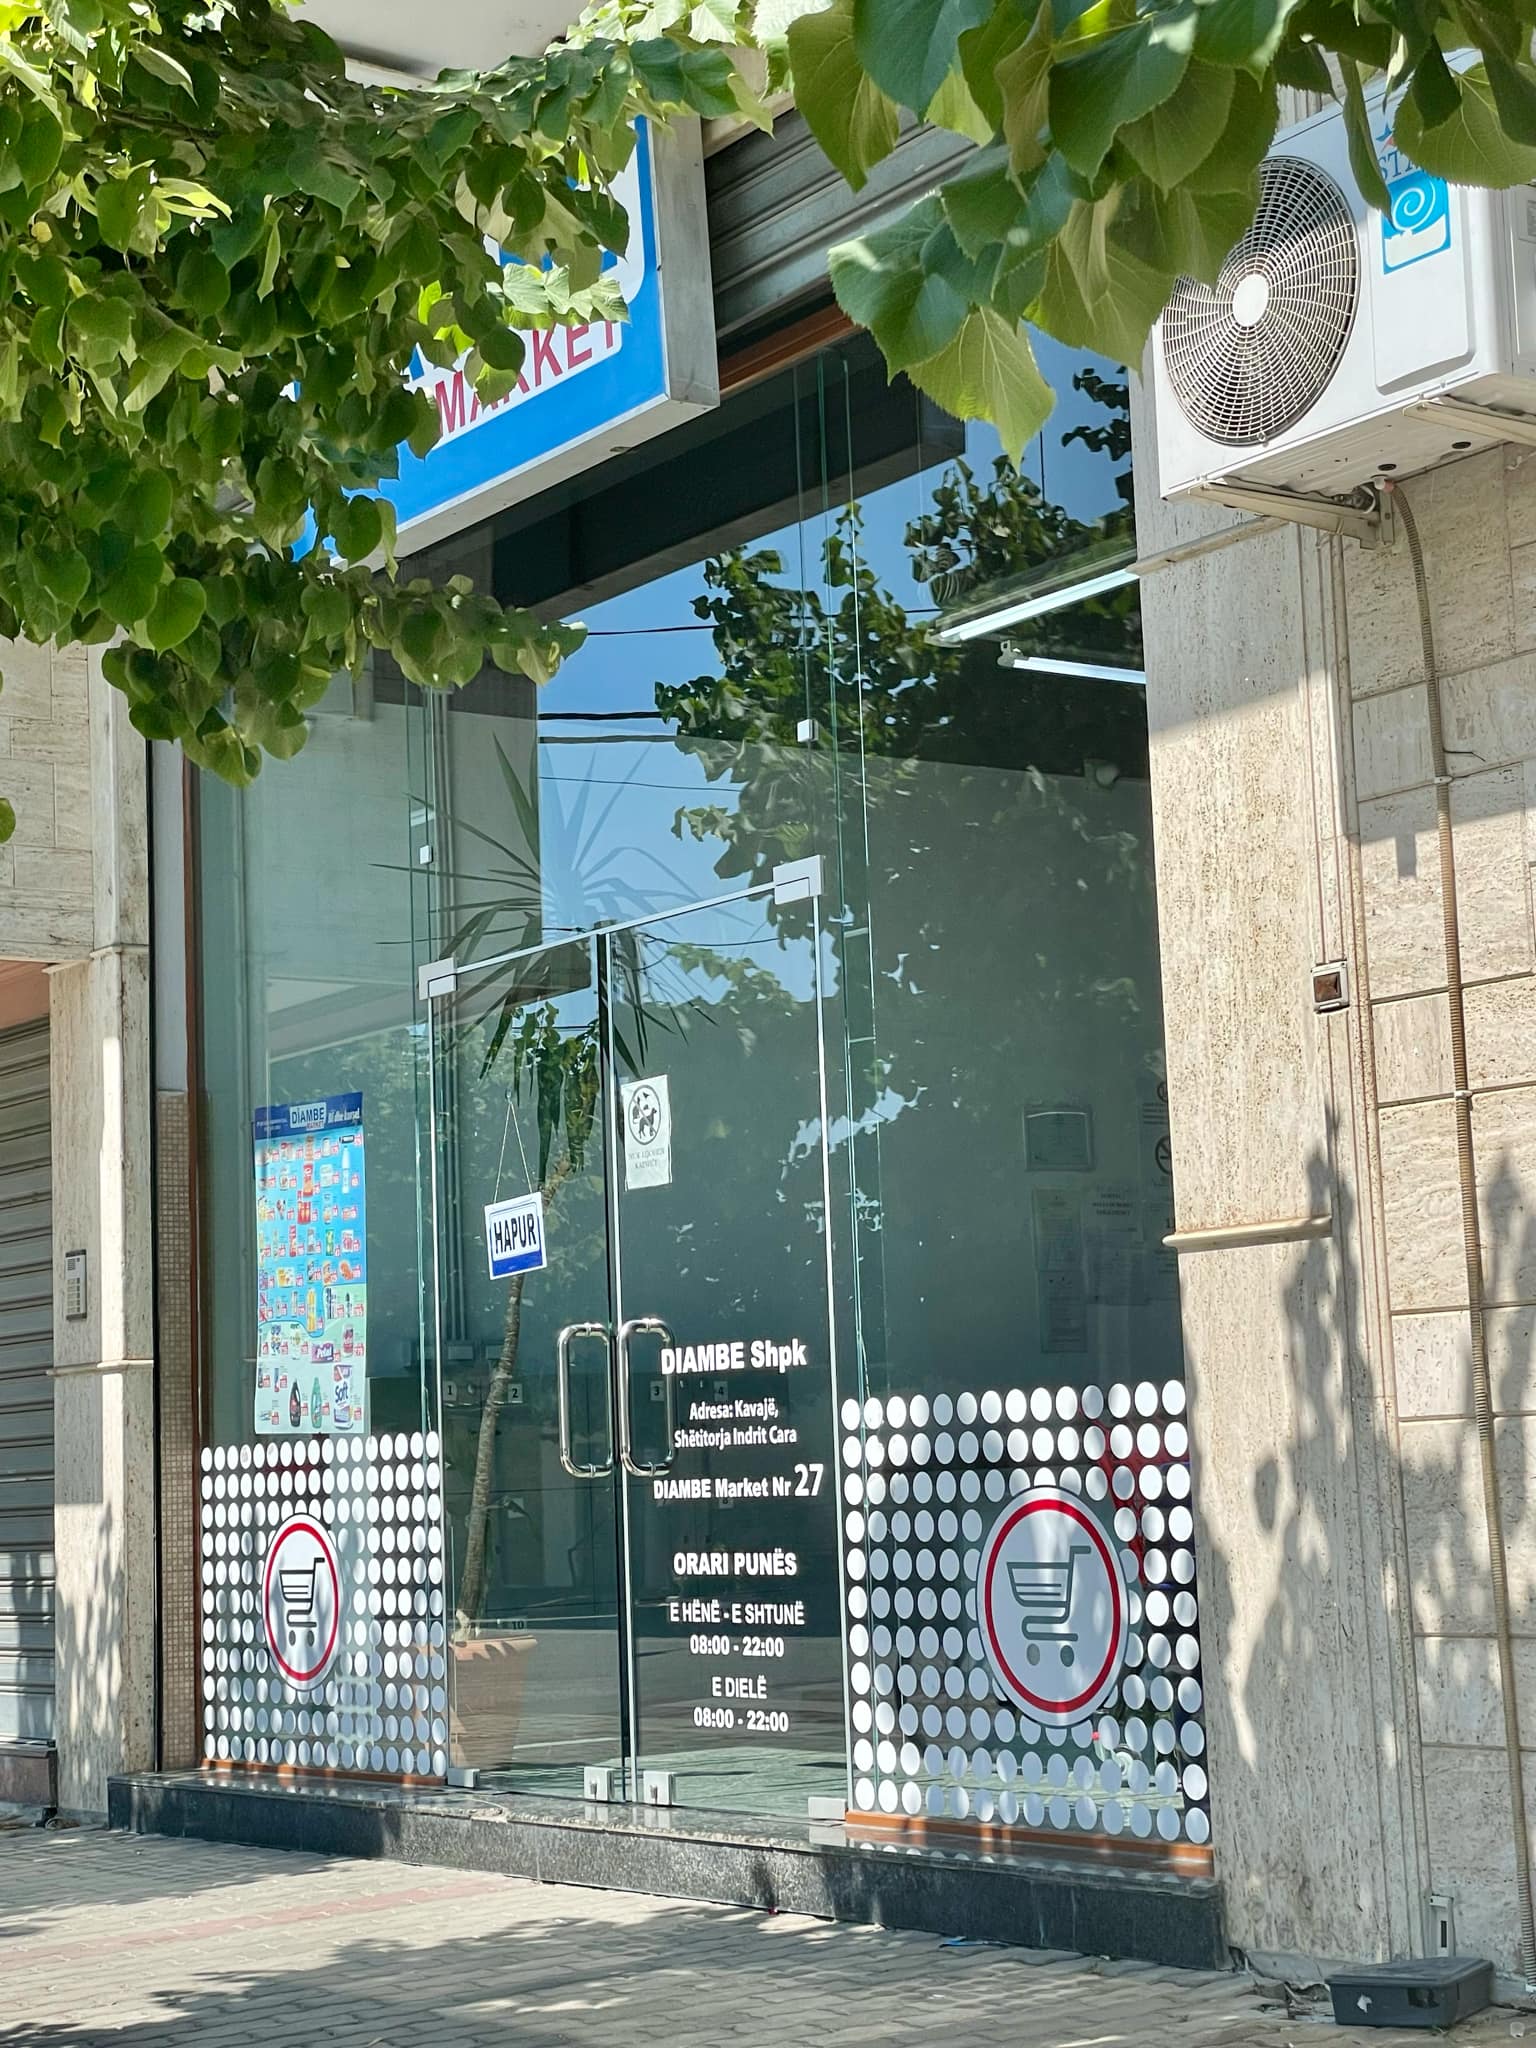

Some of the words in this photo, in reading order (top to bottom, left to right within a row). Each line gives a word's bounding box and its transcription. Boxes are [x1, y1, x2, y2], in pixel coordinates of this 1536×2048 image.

[493, 1212, 537, 1255] HAPUR
[661, 1342, 745, 1375] DIAMBE
[750, 1338, 807, 1373] Shpk
[689, 1402, 734, 1420] Adresa:
[674, 1428, 731, 1450] Shëtitorja
[734, 1426, 767, 1445] Indrit
[769, 1425, 797, 1443] Cara
[653, 1479, 712, 1499] DIAMBE
[714, 1477, 769, 1498] Market
[772, 1476, 791, 1496] Nr
[794, 1463, 824, 1496] 27
[673, 1552, 729, 1576] ORARI
[734, 1548, 797, 1576] PUNËS
[669, 1602, 679, 1622] E
[682, 1599, 720, 1623] HËNË
[732, 1603, 742, 1624] E
[745, 1600, 805, 1625] SHTUNË
[690, 1634, 730, 1655] 08:00
[742, 1636, 784, 1657] 22:00
[712, 1676, 722, 1697] E
[725, 1675, 767, 1699] DIELË
[693, 1707, 734, 1728] 08:00
[746, 1711, 789, 1732] 22:00
